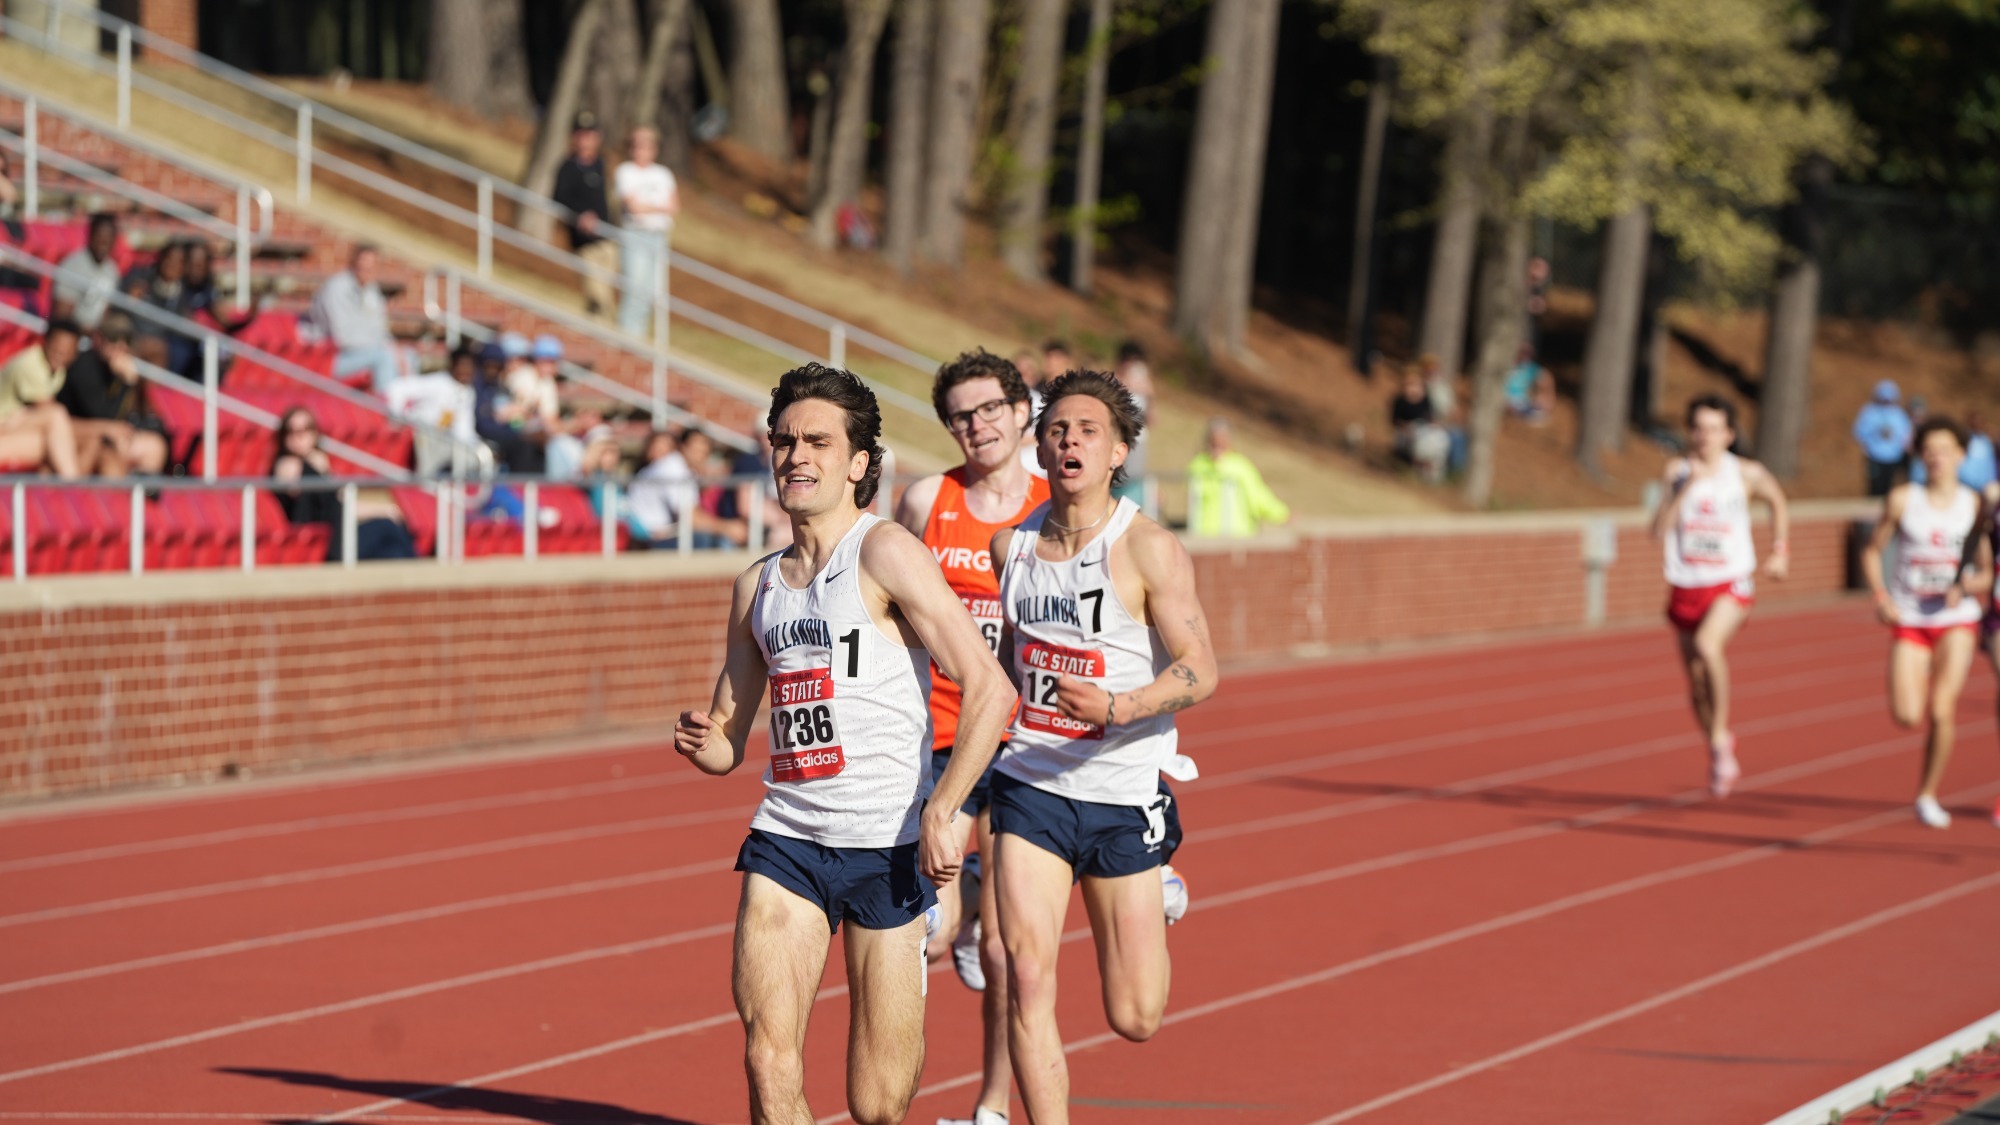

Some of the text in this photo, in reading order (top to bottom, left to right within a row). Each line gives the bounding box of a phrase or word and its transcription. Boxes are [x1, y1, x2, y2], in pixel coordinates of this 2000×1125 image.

[931, 545, 992, 573] VIRG
[1080, 587, 1104, 634] 7
[764, 618, 833, 660] VILLANOVA
[839, 628, 860, 678] 1
[1029, 647, 1049, 667] NC
[1050, 653, 1096, 676] STATE
[773, 685, 779, 704] C
[781, 678, 823, 703] STATE
[1027, 671, 1058, 708] 12
[770, 704, 834, 750] 1236
[793, 751, 839, 769] adidas
